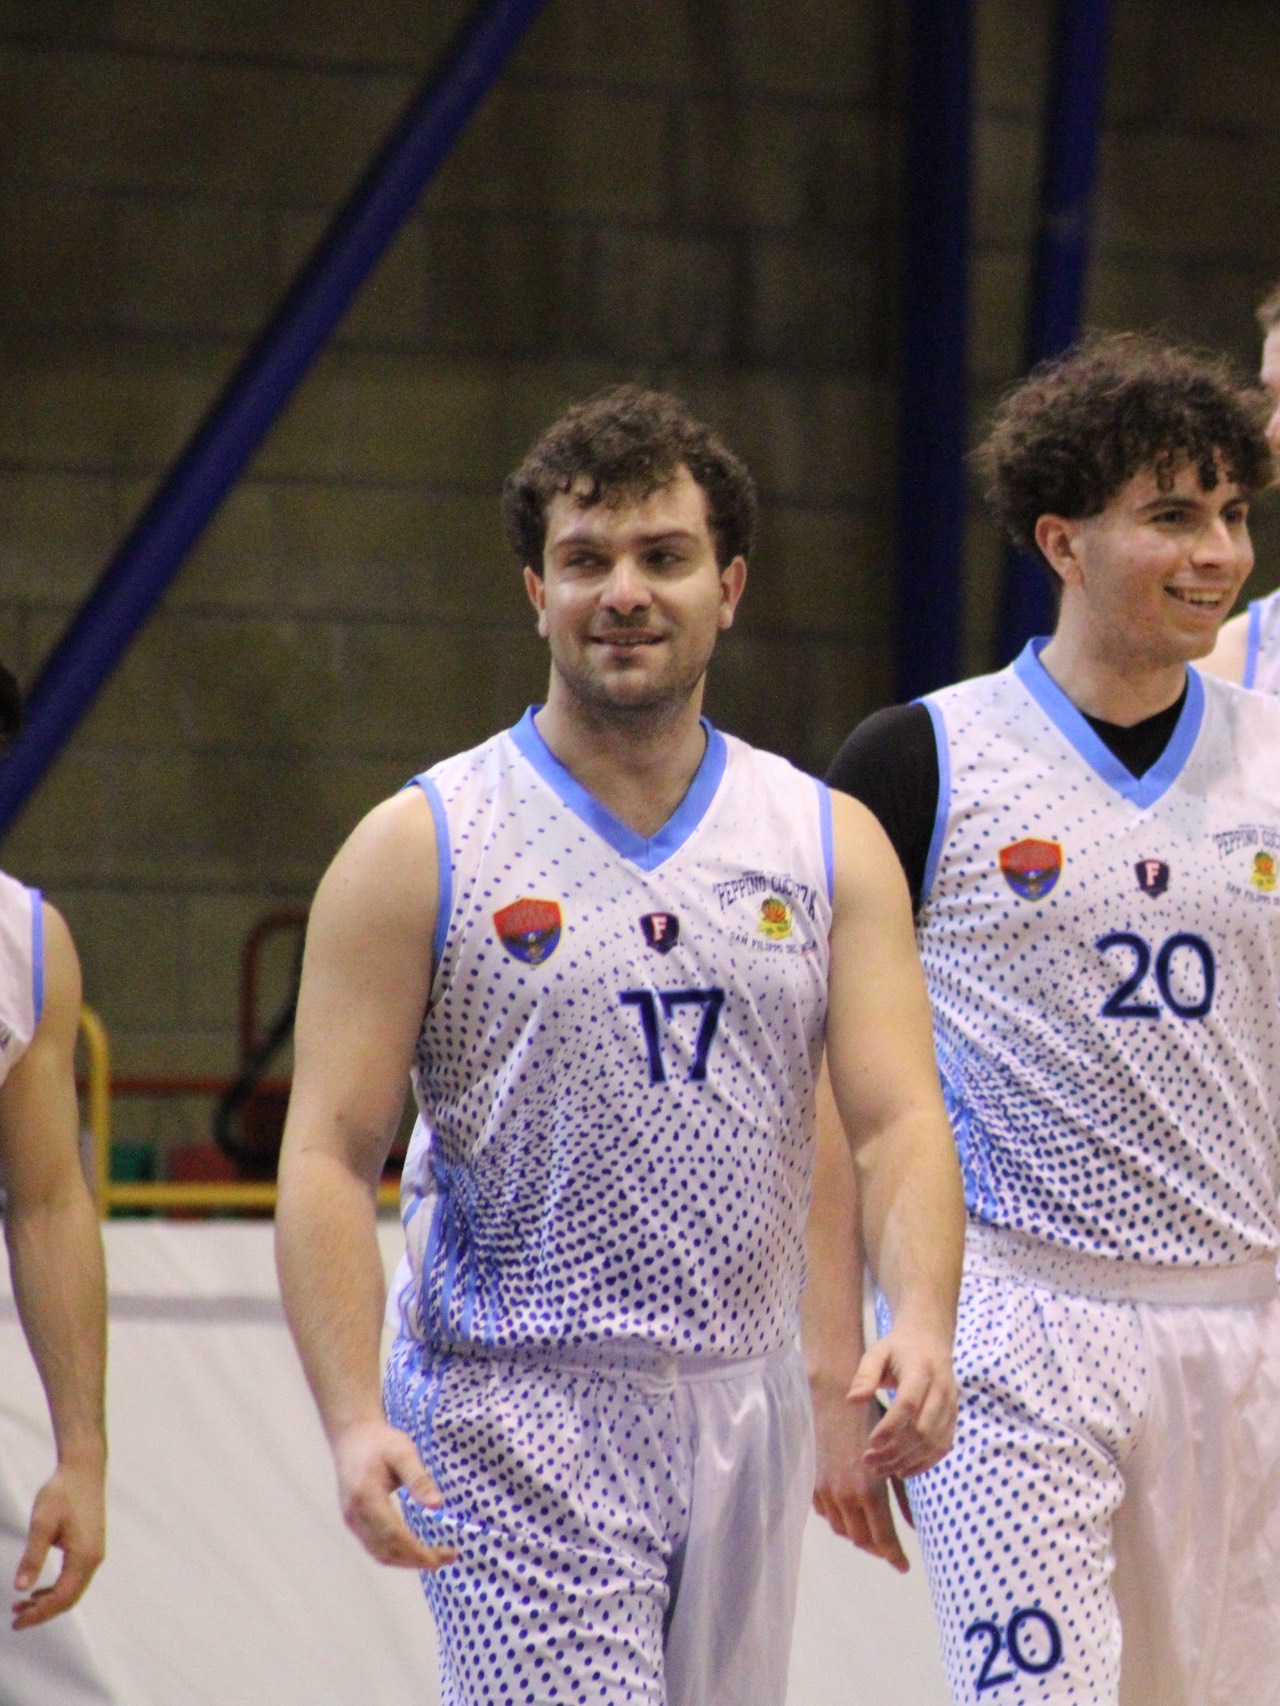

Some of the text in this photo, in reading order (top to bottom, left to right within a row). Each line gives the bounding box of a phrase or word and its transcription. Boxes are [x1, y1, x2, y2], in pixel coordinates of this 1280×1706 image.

[1145, 862, 1160, 887] F
[651, 915, 668, 942] F
[1095, 931, 1216, 1019] 20
[617, 987, 726, 1083] 17
[964, 1608, 1063, 1691] 20
